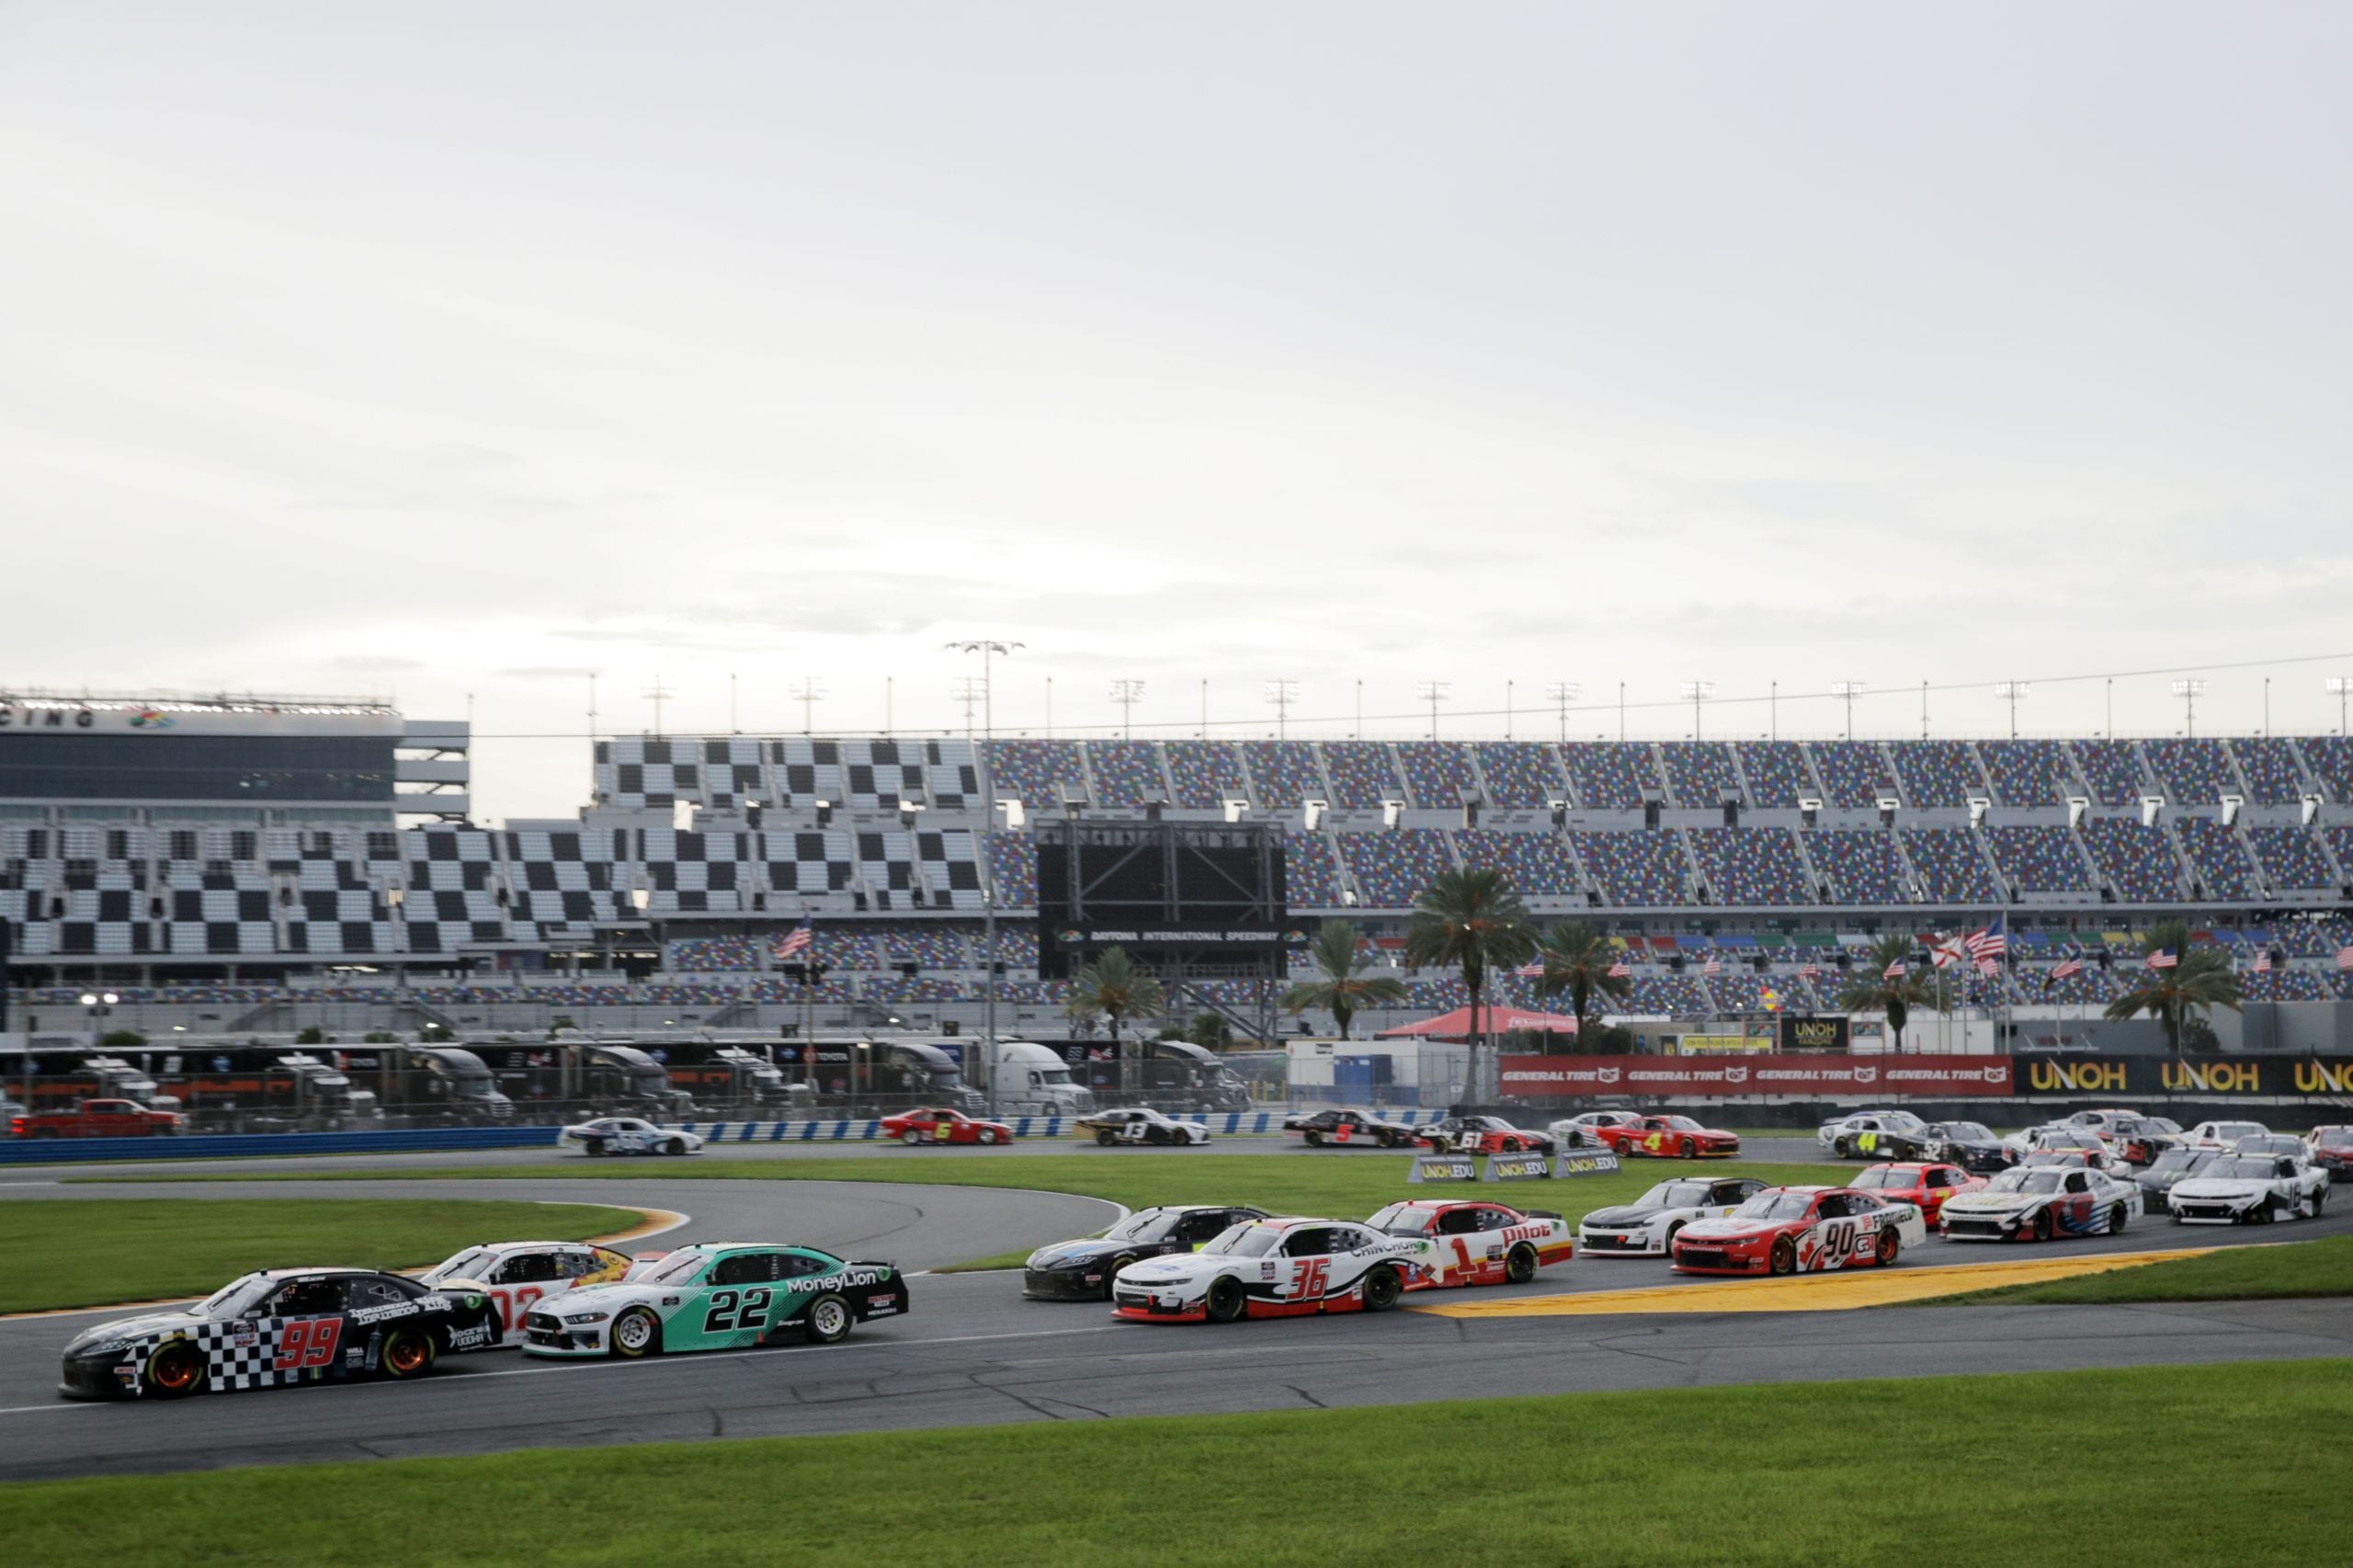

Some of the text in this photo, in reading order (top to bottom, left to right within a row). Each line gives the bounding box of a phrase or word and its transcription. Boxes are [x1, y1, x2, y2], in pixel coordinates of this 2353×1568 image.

[1091, 931, 1279, 941] DAYTONA INTERNATIONAL SPEEDWAY
[1795, 1022, 1836, 1037] UNOH
[1502, 1071, 1566, 1081] GENERAL
[1566, 1071, 1597, 1081] TIRE
[1628, 1071, 1691, 1081] GENERAL
[1692, 1071, 1723, 1081] TIRE
[1756, 1070, 1819, 1080] GENERAL
[1821, 1070, 1852, 1080] TIRE
[1886, 1070, 1949, 1080] GENERAL
[1951, 1070, 1982, 1080] TIRE
[2030, 1058, 2126, 1090] UNOH
[2162, 1059, 2259, 1091] UNOH
[935, 1123, 952, 1139] 6
[1124, 1122, 1148, 1139] 13
[1336, 1124, 1354, 1142] 5
[1461, 1132, 1483, 1148] 61
[1643, 1132, 1662, 1151] 4
[1858, 1132, 1878, 1152] 44
[1422, 1164, 1474, 1178] UNOH.EDU
[1495, 1161, 1548, 1177] UNOH.EDU
[1565, 1156, 1618, 1173] UNOH.EDU
[1936, 1190, 1950, 1220] 7
[1824, 1221, 1855, 1258] 90
[1450, 1238, 1479, 1275] 1
[786, 1271, 876, 1293] MoneyLion
[1286, 1257, 1331, 1301] 36
[358, 1305, 420, 1326] Insurance
[702, 1287, 773, 1334] 22
[275, 1317, 344, 1370] 99
